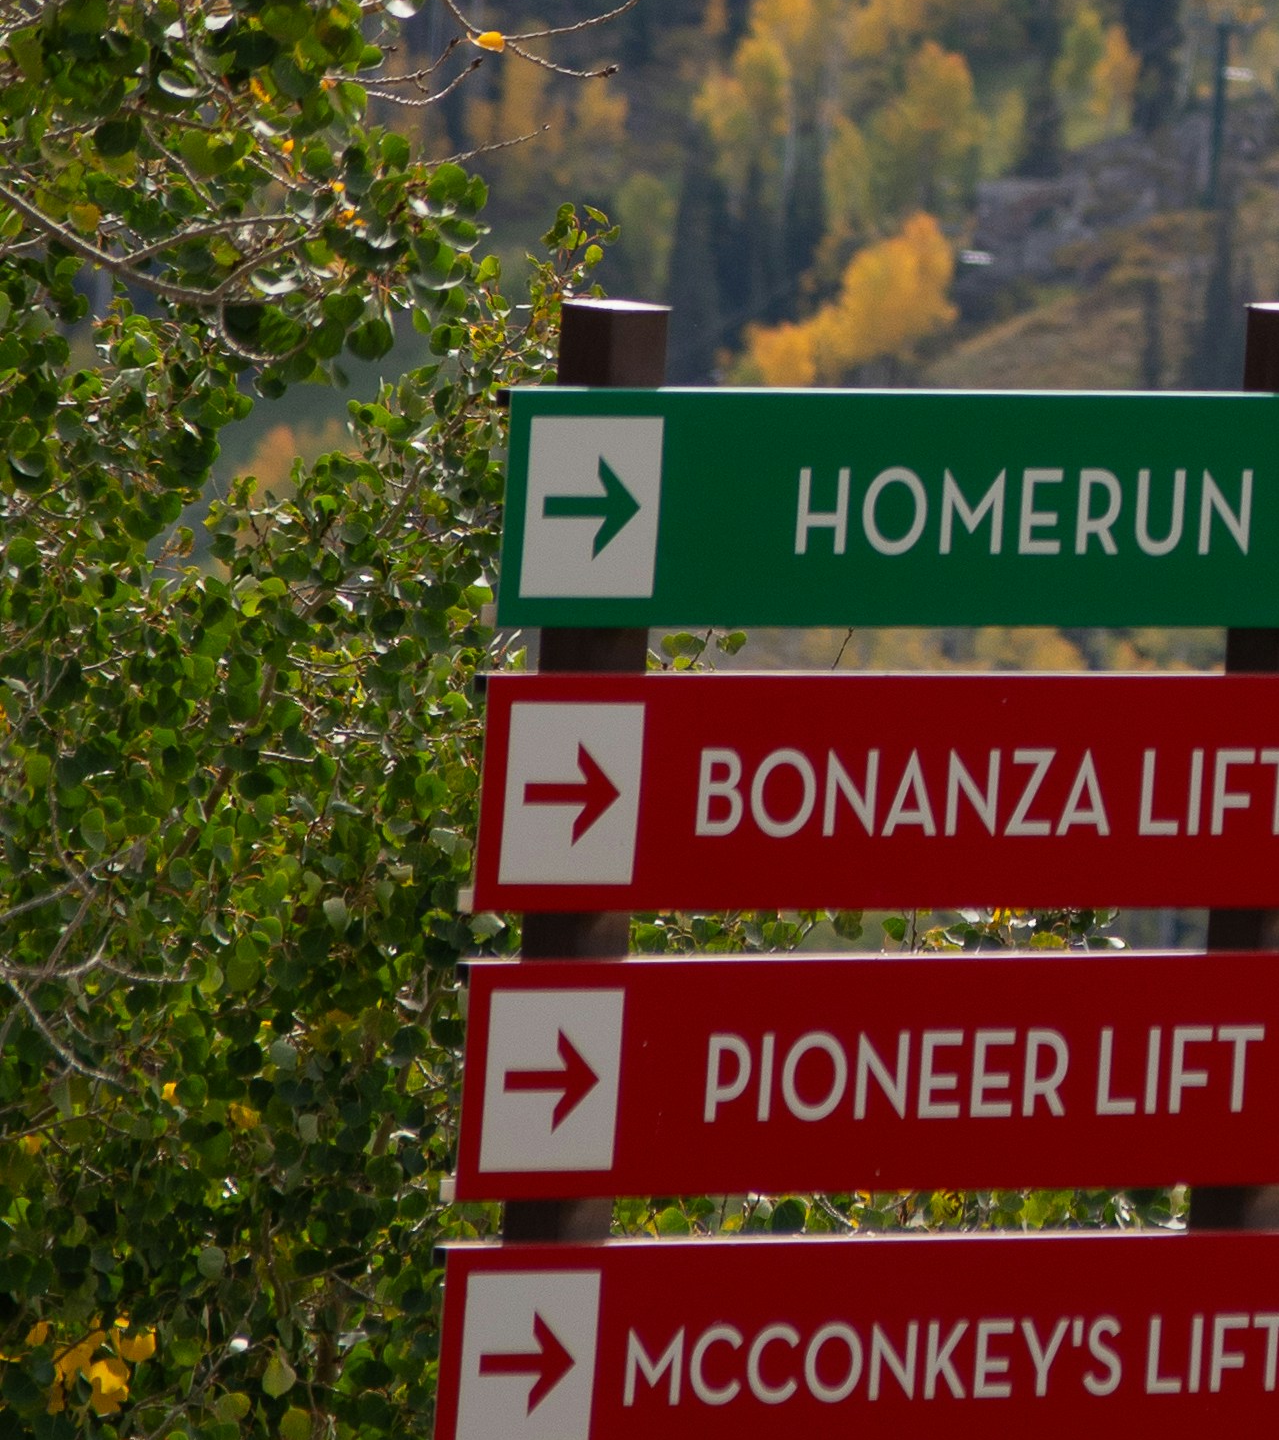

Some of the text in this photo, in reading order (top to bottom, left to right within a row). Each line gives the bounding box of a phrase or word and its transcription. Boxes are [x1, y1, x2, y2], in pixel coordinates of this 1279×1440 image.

[795, 467, 1253, 555] HOMERUN
[696, 749, 1109, 837] BONANZA
[705, 1026, 1264, 1122] PIONEER LIFT
[624, 1317, 1121, 1405] MCCONKEY'S
